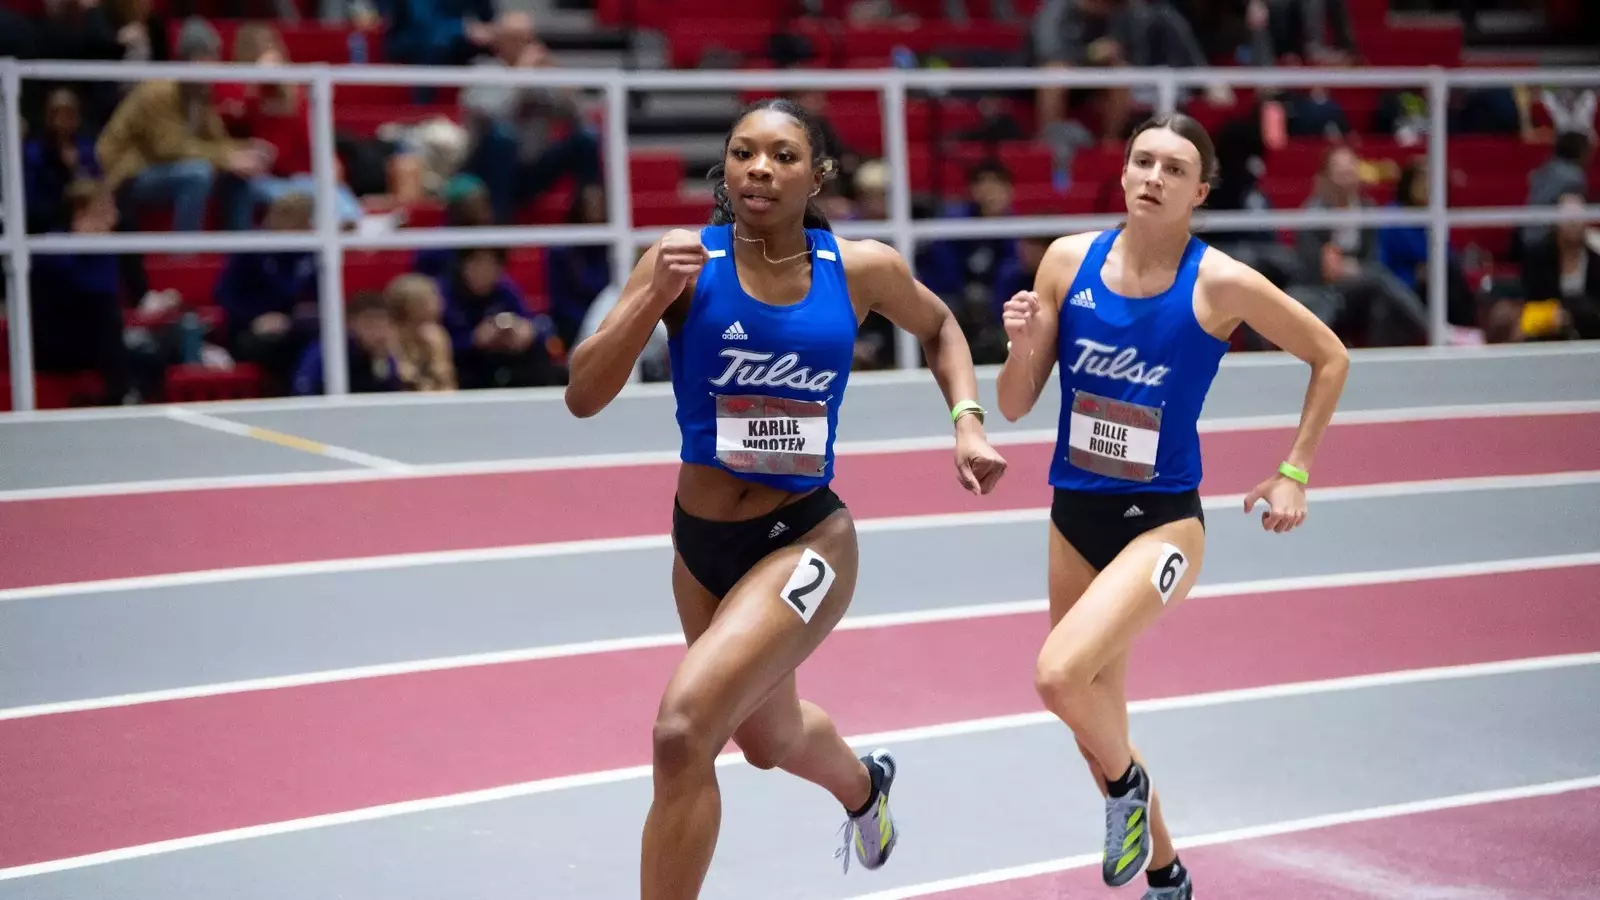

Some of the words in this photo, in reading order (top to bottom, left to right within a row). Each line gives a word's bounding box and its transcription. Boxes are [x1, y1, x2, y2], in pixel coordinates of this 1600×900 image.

[721, 332, 749, 341] adidas
[708, 347, 838, 393] Tulsa
[1068, 337, 1172, 386] Tulsa
[747, 419, 801, 437] KARLIE
[1092, 420, 1129, 442] BILLIE
[742, 437, 806, 452] WOOTEN
[1088, 436, 1129, 459] ROUSE
[1159, 551, 1184, 594] 6
[787, 557, 826, 614] 2
